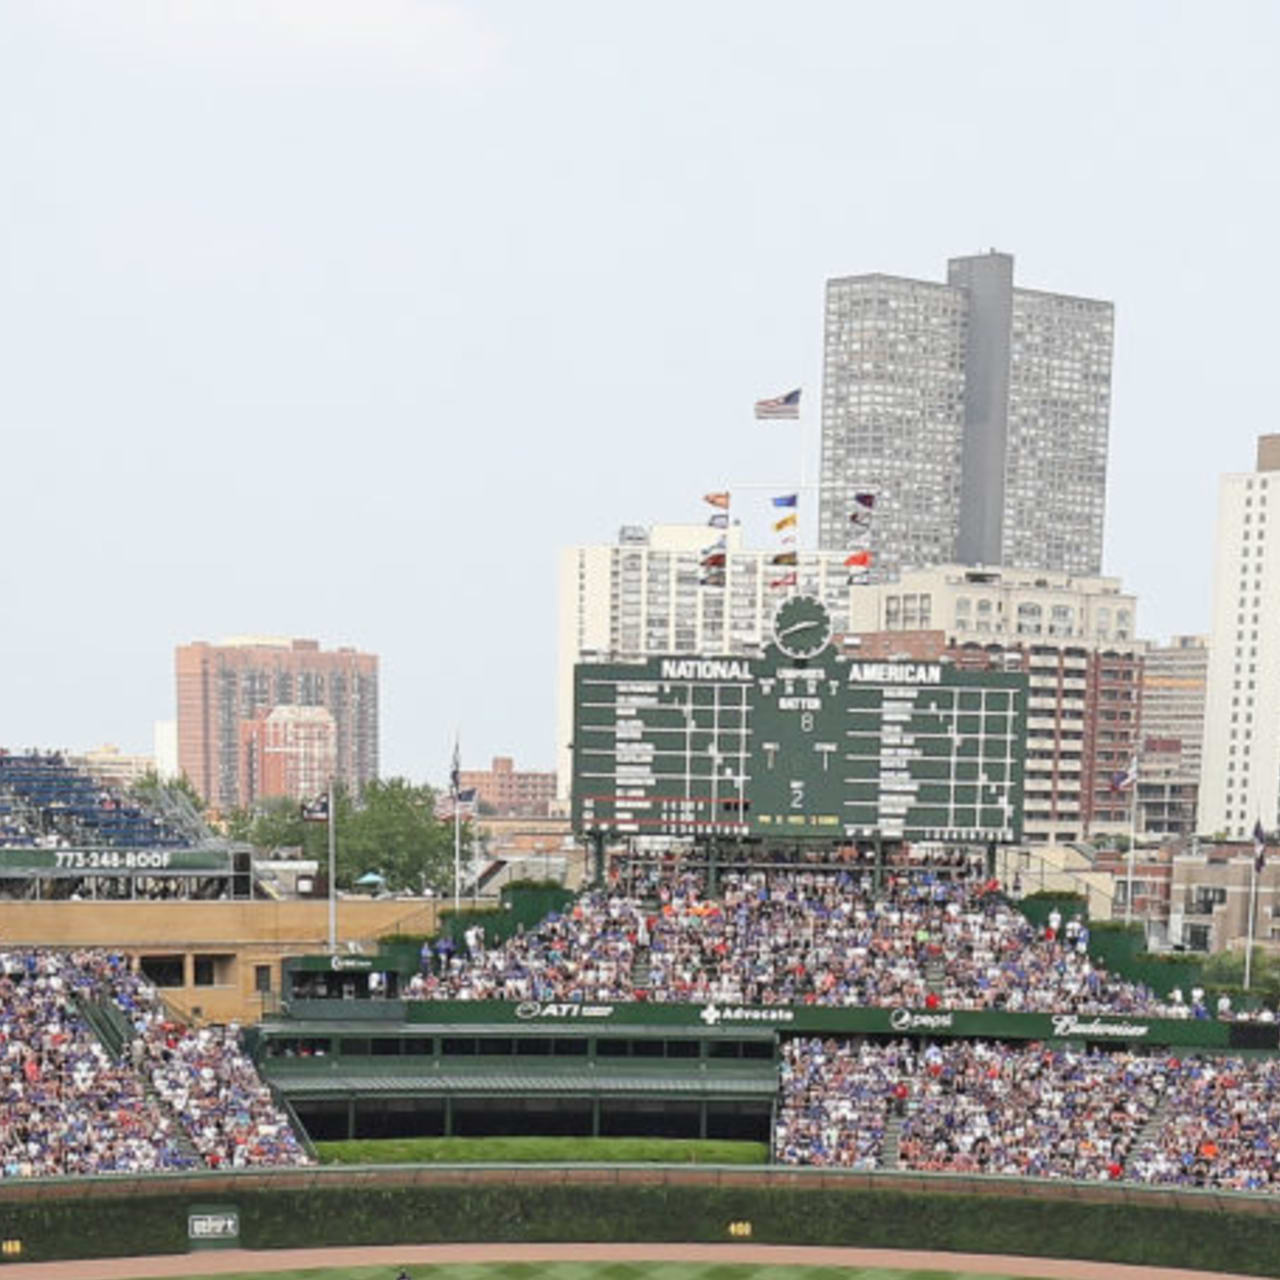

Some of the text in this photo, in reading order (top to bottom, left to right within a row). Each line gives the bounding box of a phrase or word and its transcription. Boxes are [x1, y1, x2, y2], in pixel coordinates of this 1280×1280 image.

[661, 660, 754, 679] NATIONAL
[849, 664, 941, 683] AMERICAN
[801, 712, 814, 732] 8
[790, 790, 803, 808] 2
[540, 1004, 579, 1017] ATI
[722, 1007, 793, 1021] Advocate
[912, 1013, 952, 1028] pepsi
